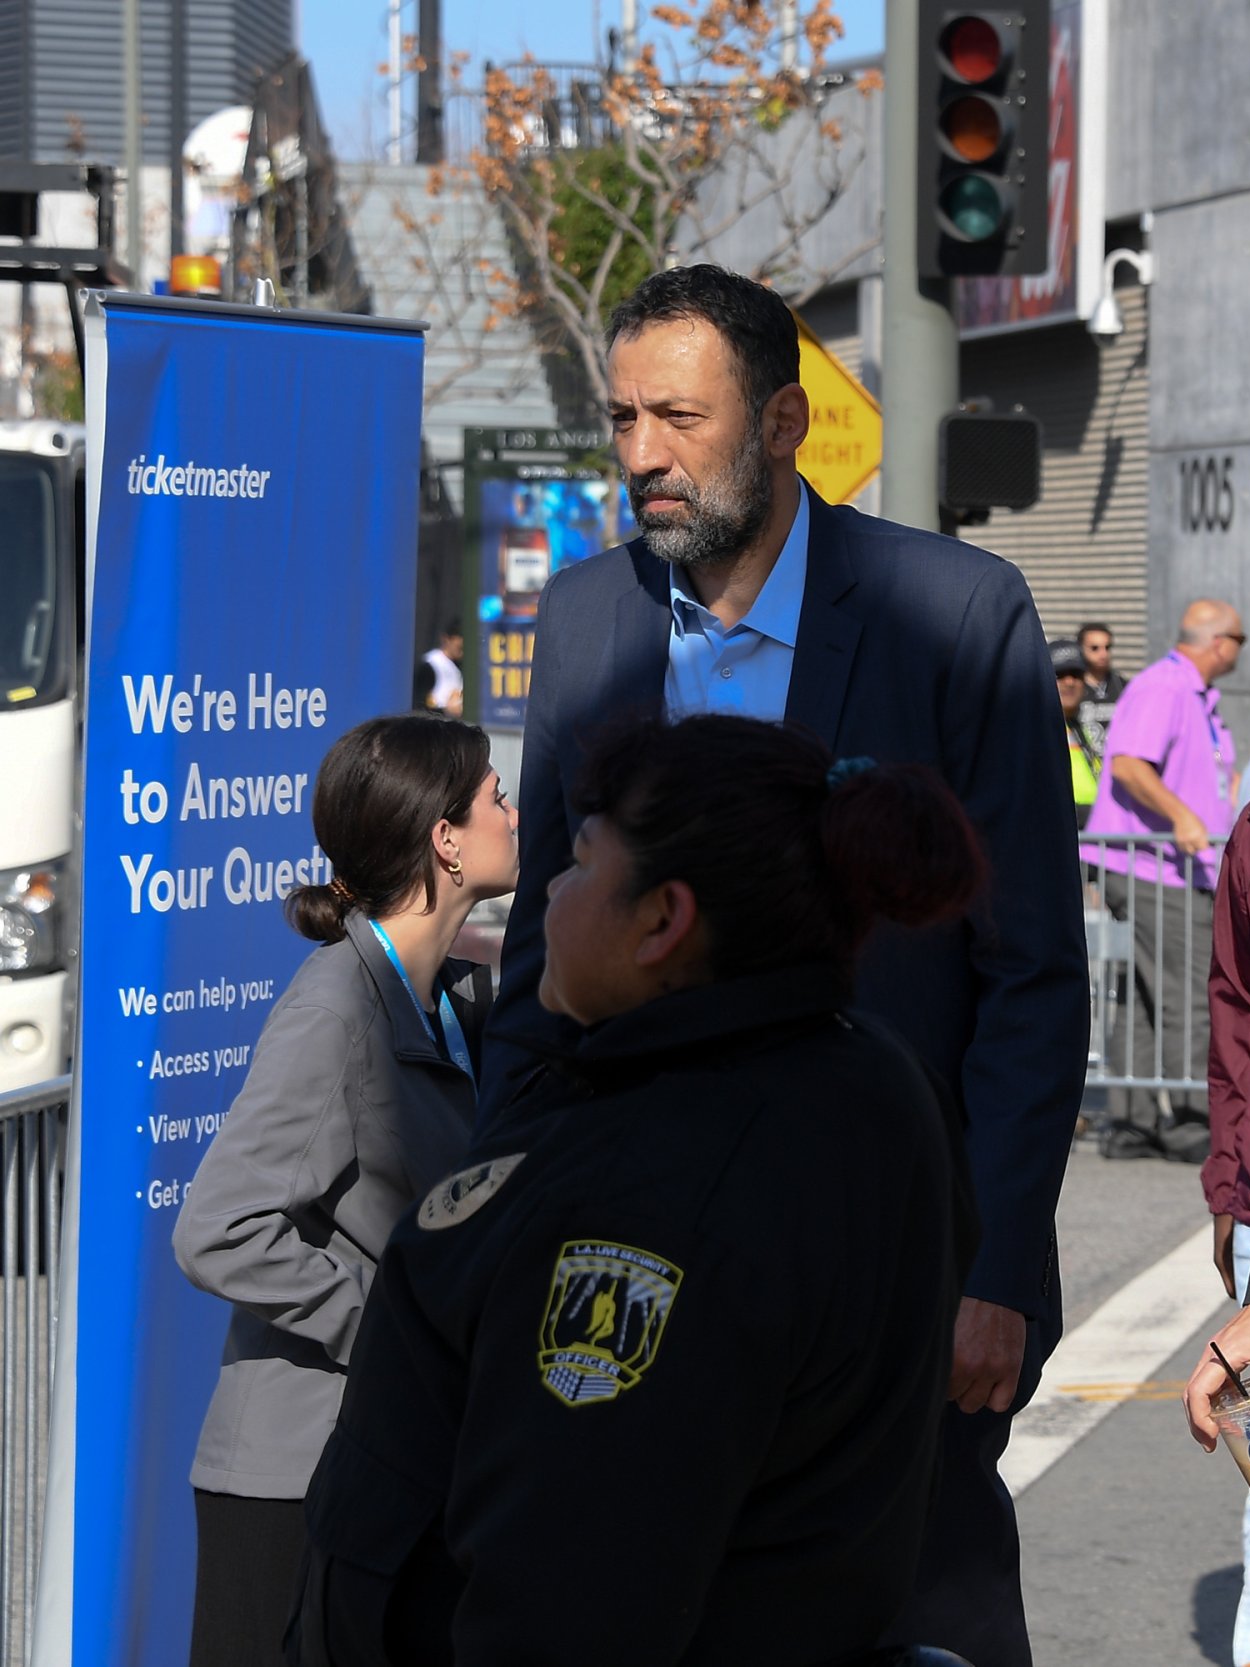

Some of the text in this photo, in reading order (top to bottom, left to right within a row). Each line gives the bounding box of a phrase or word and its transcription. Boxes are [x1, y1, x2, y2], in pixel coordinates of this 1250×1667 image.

[127, 454, 271, 498] ticketmaster
[1179, 456, 1234, 532] 1005
[121, 672, 328, 734] We're Here
[120, 762, 307, 825] to Answer
[119, 854, 213, 914] Your
[118, 976, 274, 1017] We can help you:
[149, 1045, 250, 1080] Access your
[149, 1114, 191, 1144] View
[148, 1179, 179, 1209] Get
[596, 1245, 618, 1257] LIVE
[619, 1248, 671, 1277] SECURITY
[553, 1351, 622, 1378] OFFICER
